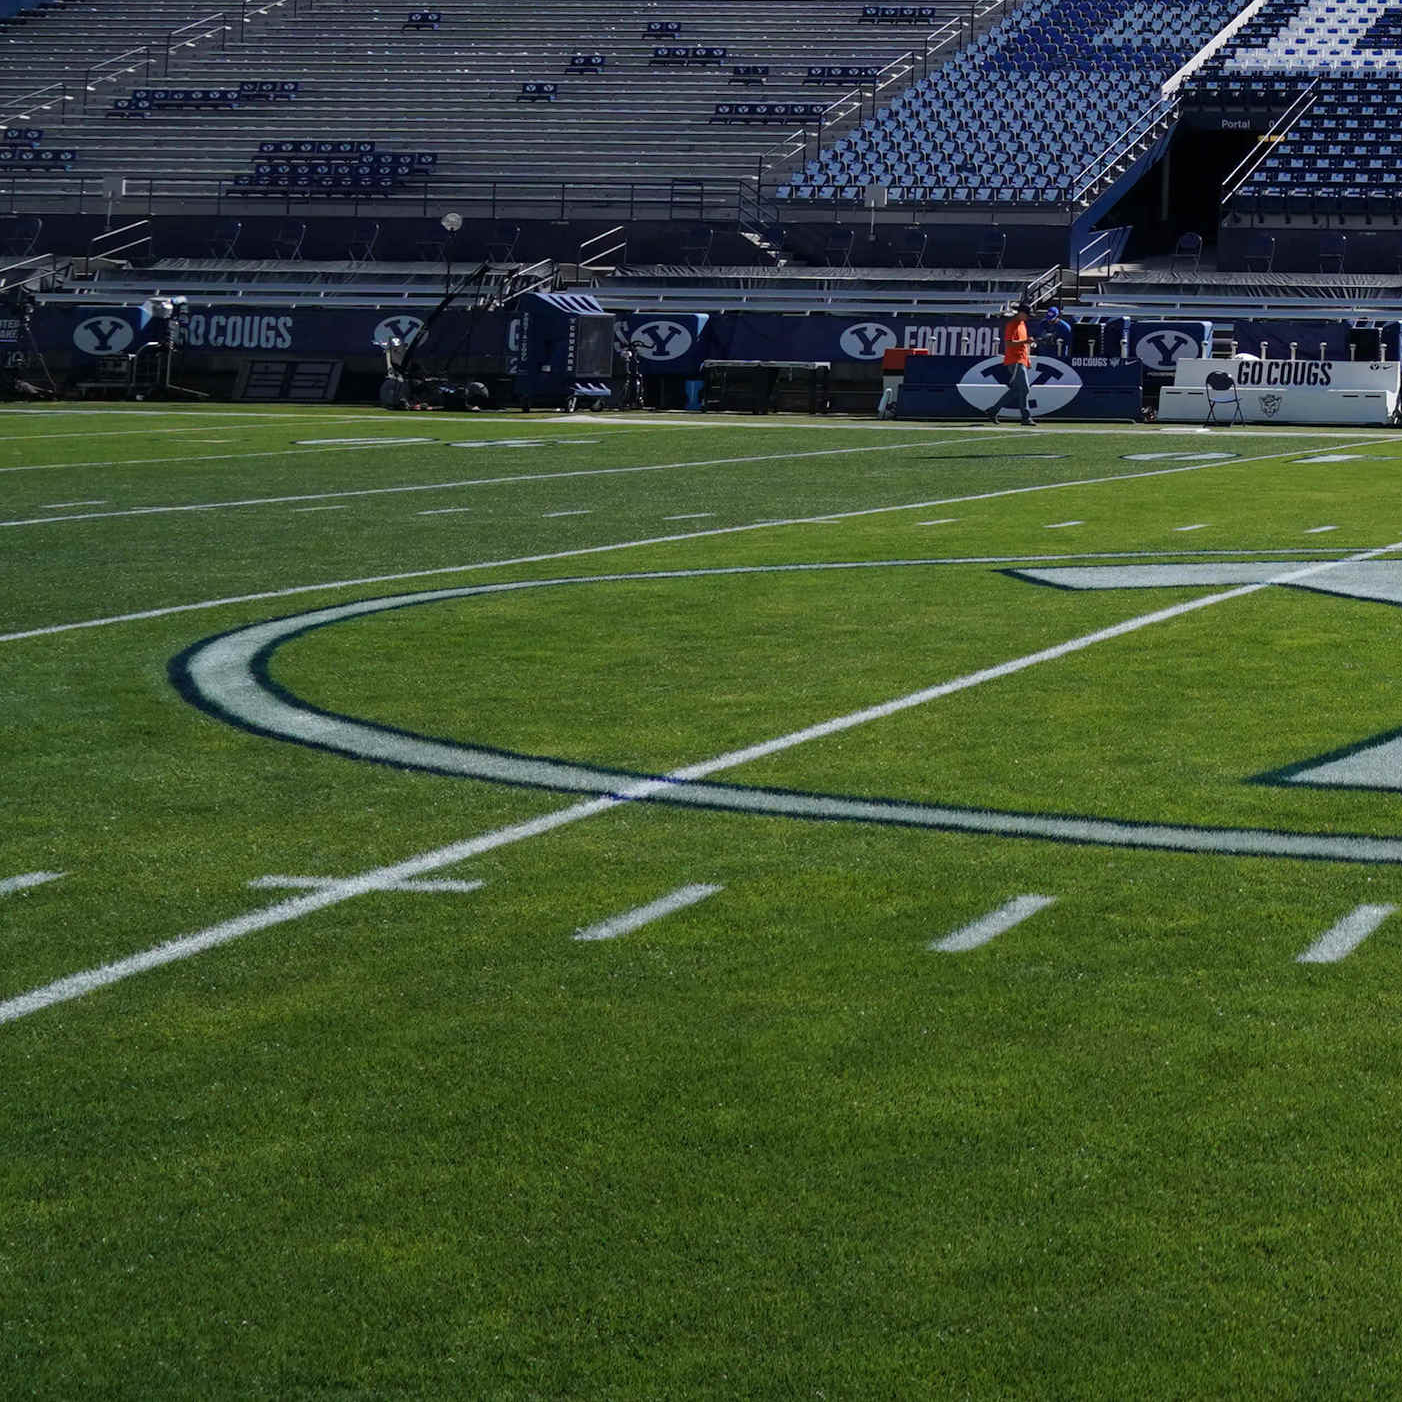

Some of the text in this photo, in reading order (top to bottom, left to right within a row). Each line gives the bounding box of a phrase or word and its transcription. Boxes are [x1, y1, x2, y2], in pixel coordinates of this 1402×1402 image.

[1221, 119, 1250, 133] Portal
[208, 315, 293, 350] COUGS
[1071, 357, 1083, 367] GO
[1238, 361, 1332, 386] GO COUGS
